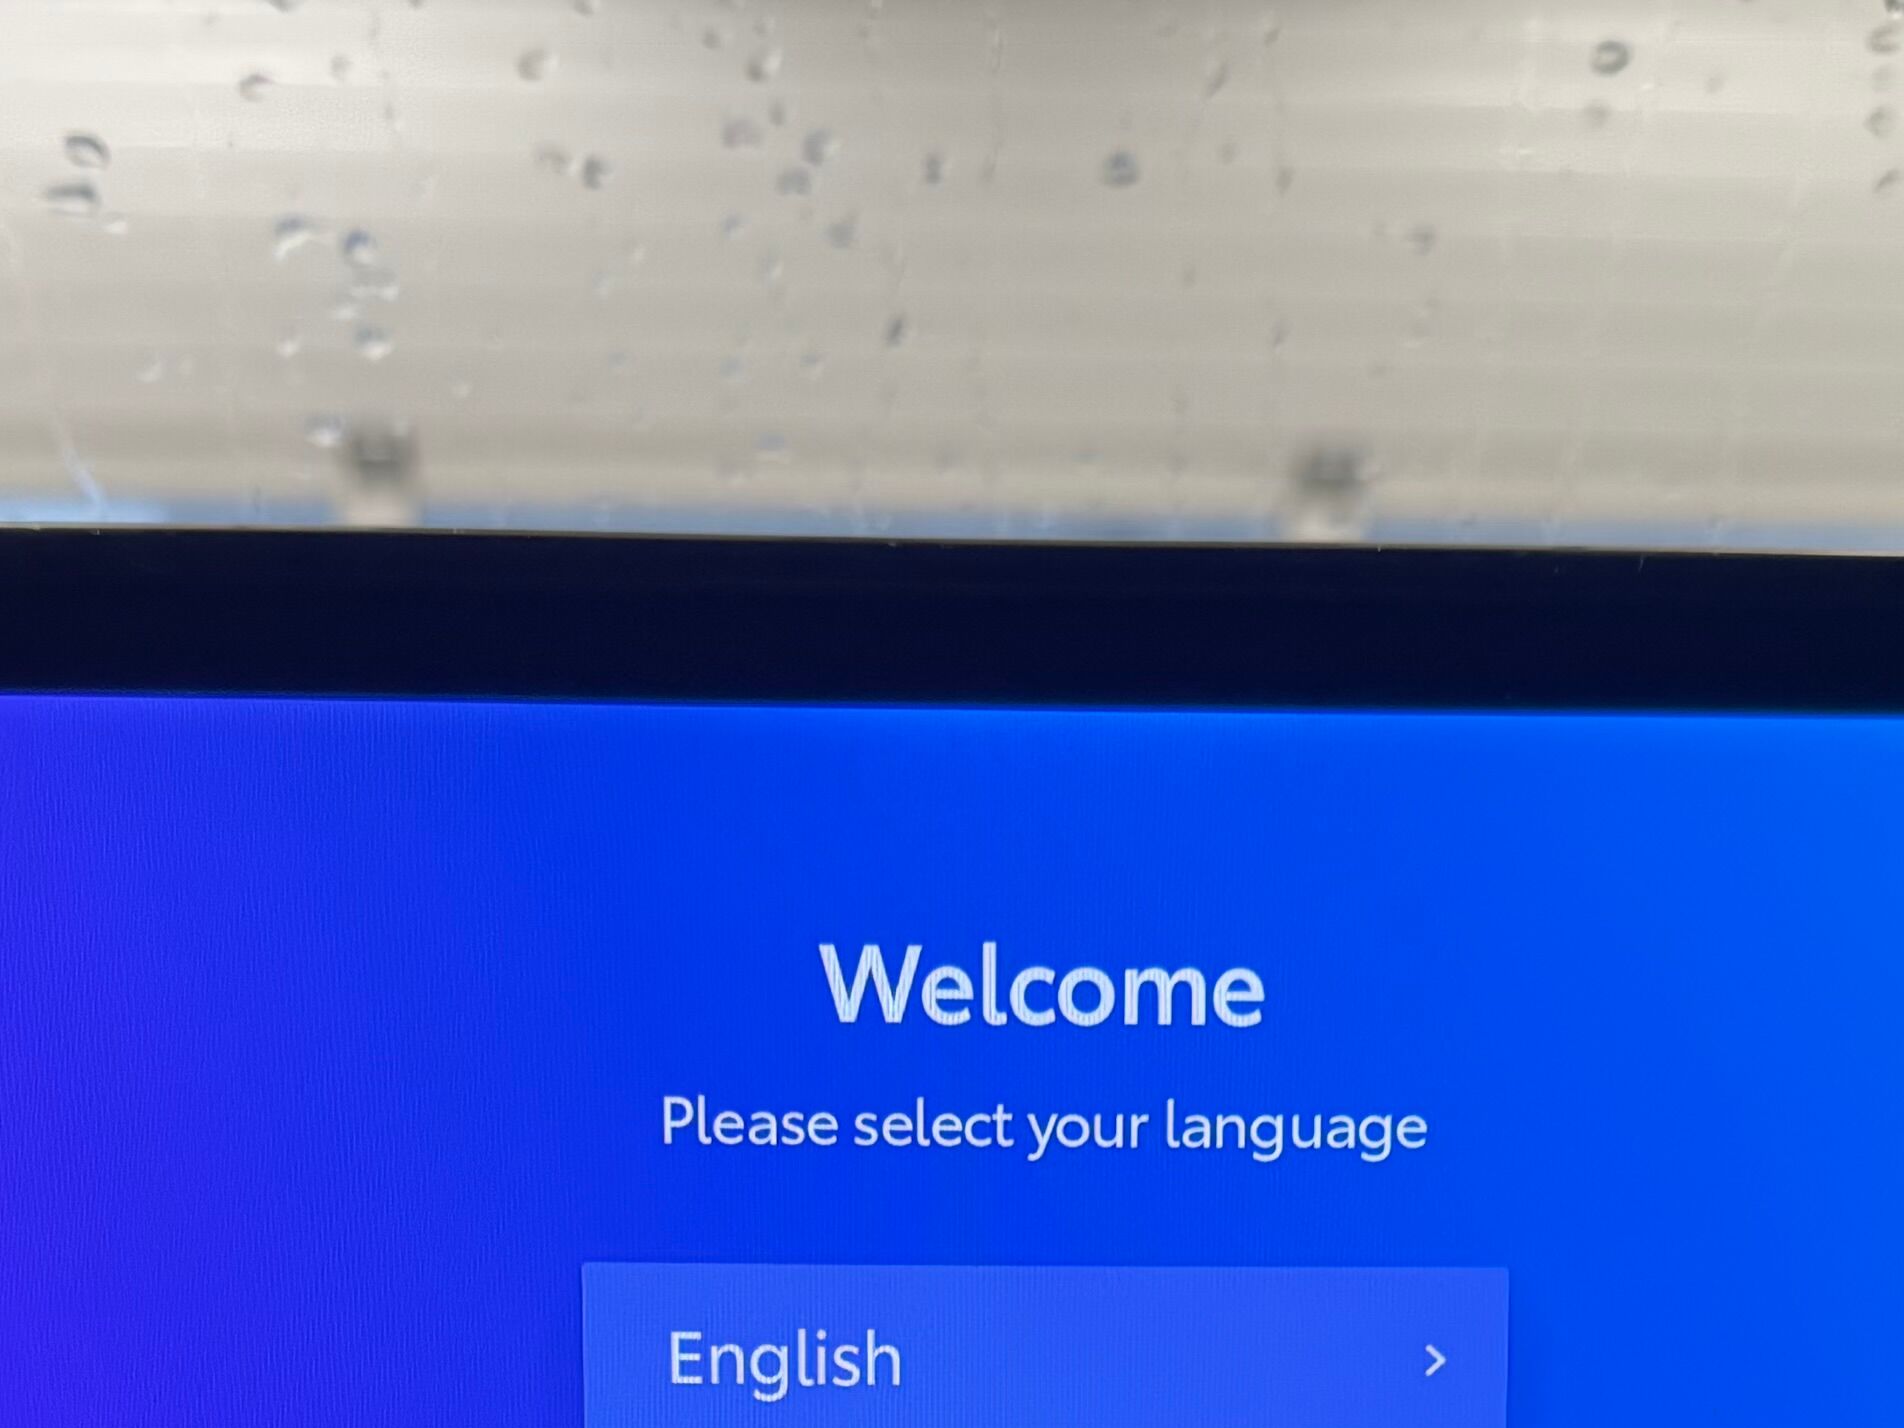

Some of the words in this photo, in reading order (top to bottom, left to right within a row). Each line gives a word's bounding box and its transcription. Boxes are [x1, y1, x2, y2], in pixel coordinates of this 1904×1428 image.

[819, 942, 1264, 1027] Welcome
[664, 1095, 838, 1145] Please
[854, 1097, 1010, 1146] select
[1026, 1109, 1148, 1161] your
[1167, 1099, 1427, 1162] language
[671, 1329, 900, 1402] English
